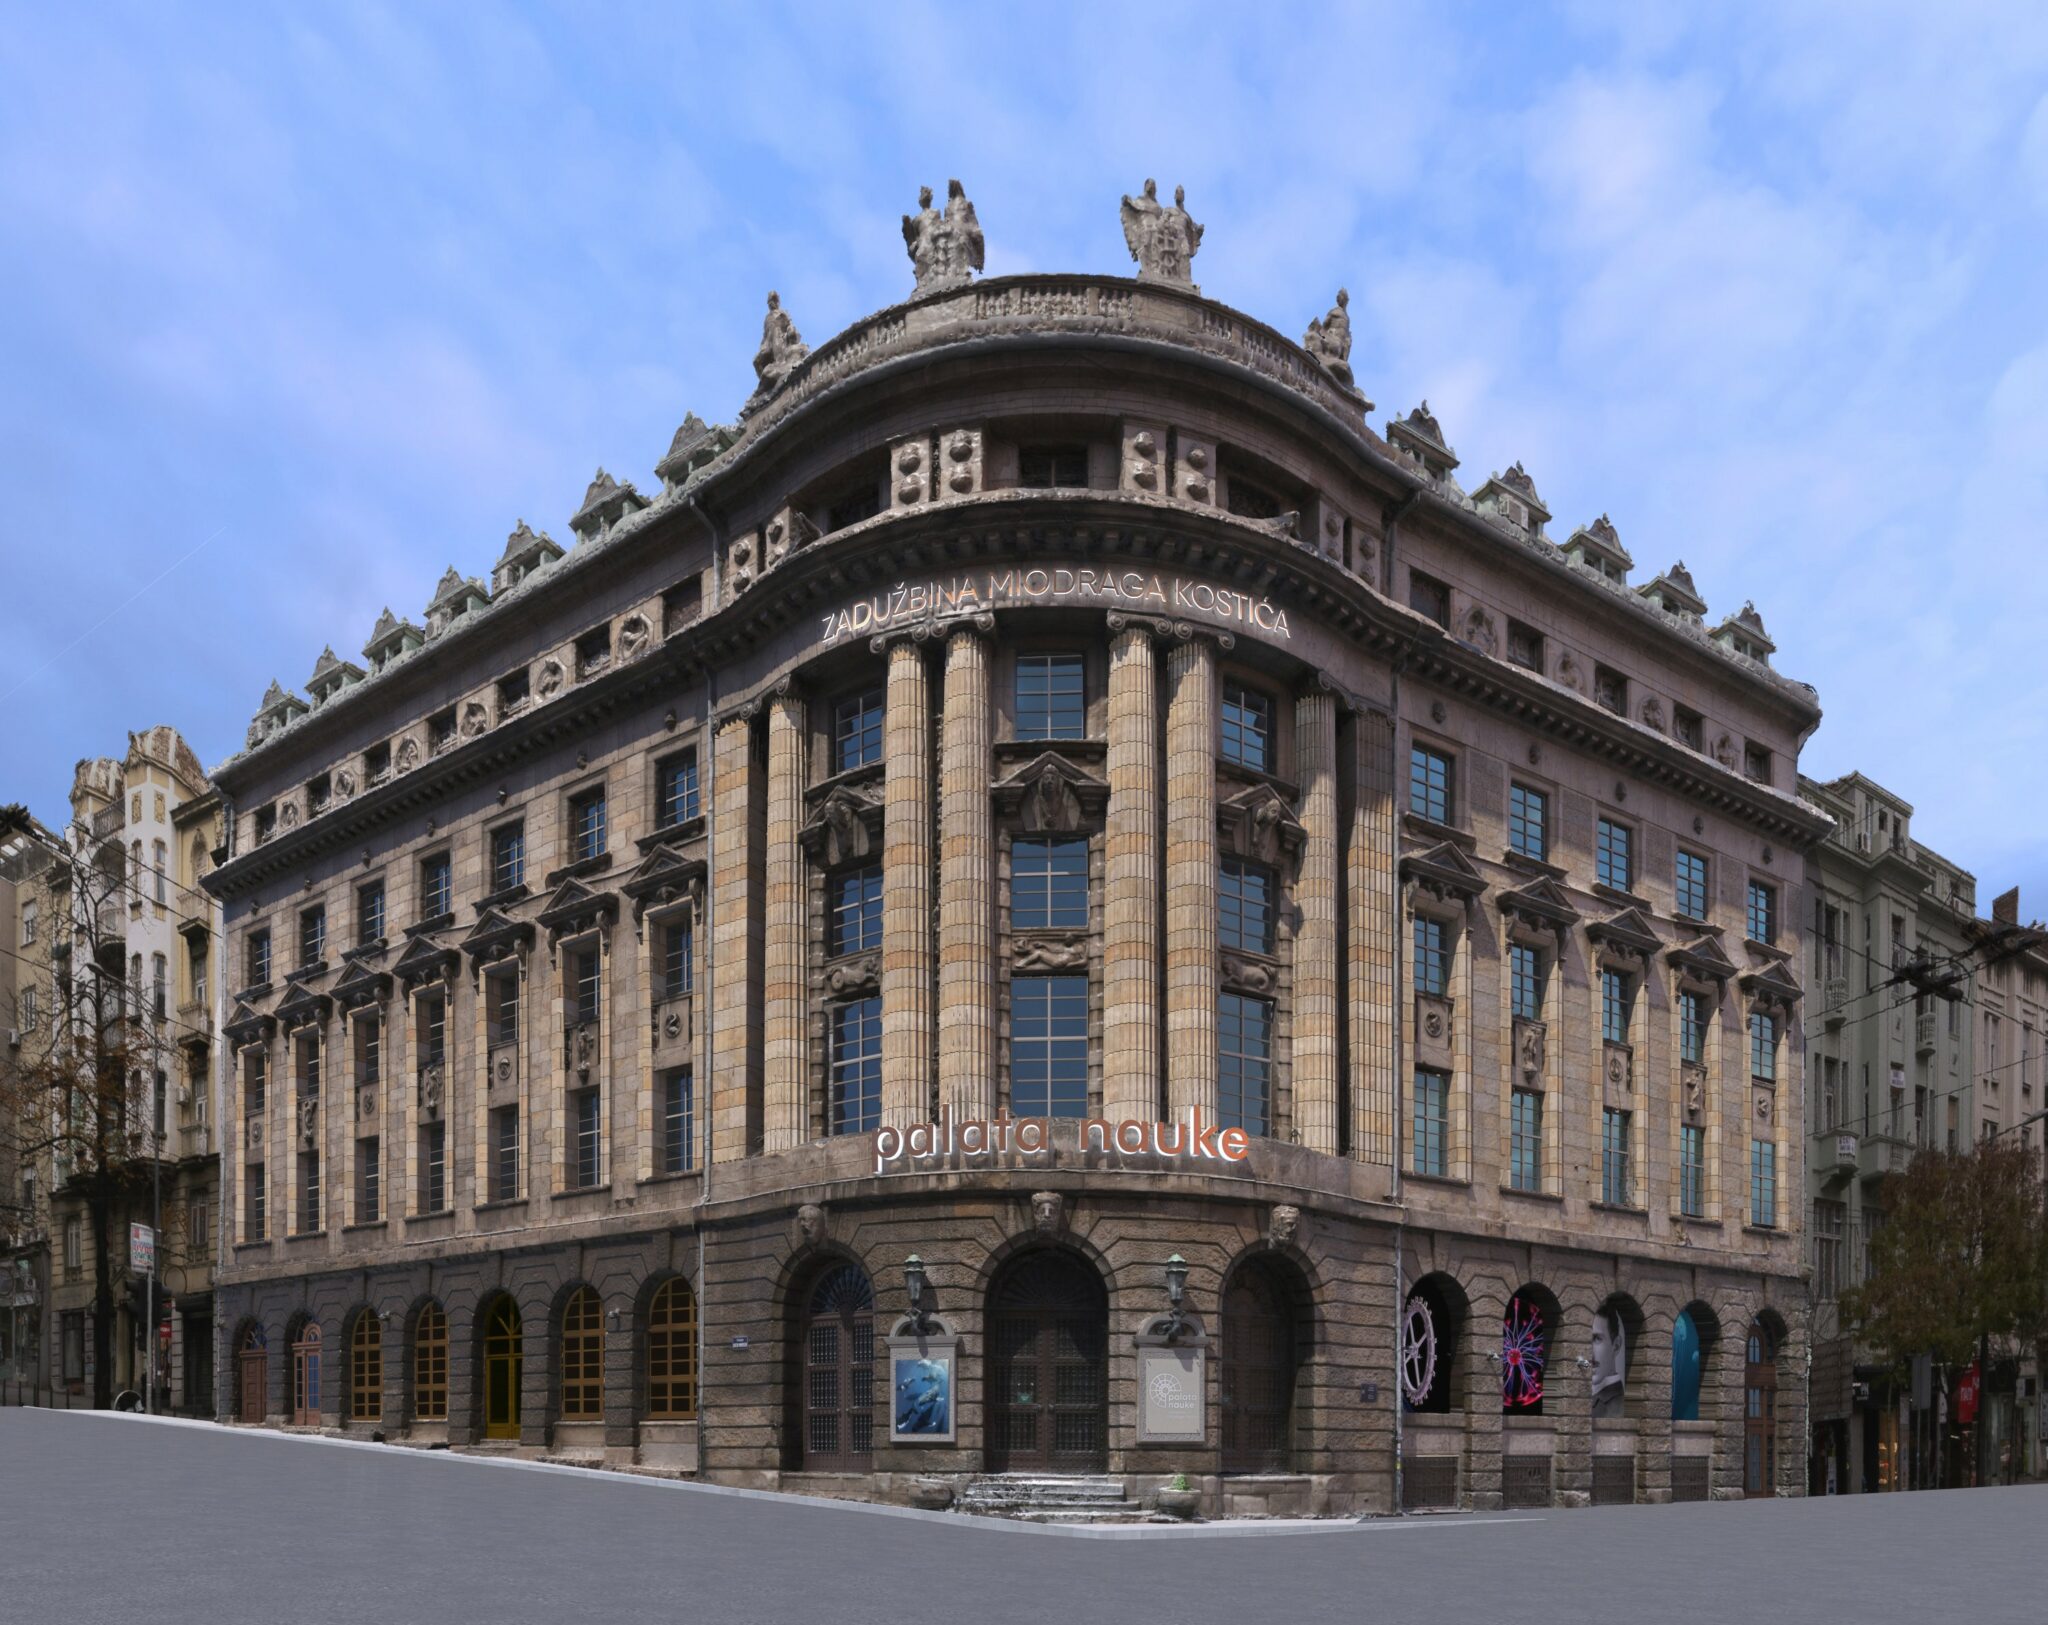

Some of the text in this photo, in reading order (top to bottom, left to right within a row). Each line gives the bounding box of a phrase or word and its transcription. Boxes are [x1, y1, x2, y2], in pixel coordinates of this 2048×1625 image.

[821, 569, 1292, 643] ZADUŽBINA MIODRAGA KOSTIĆA
[871, 1103, 1250, 1175] palata nauke
[1168, 1401, 1195, 1409] nauke
